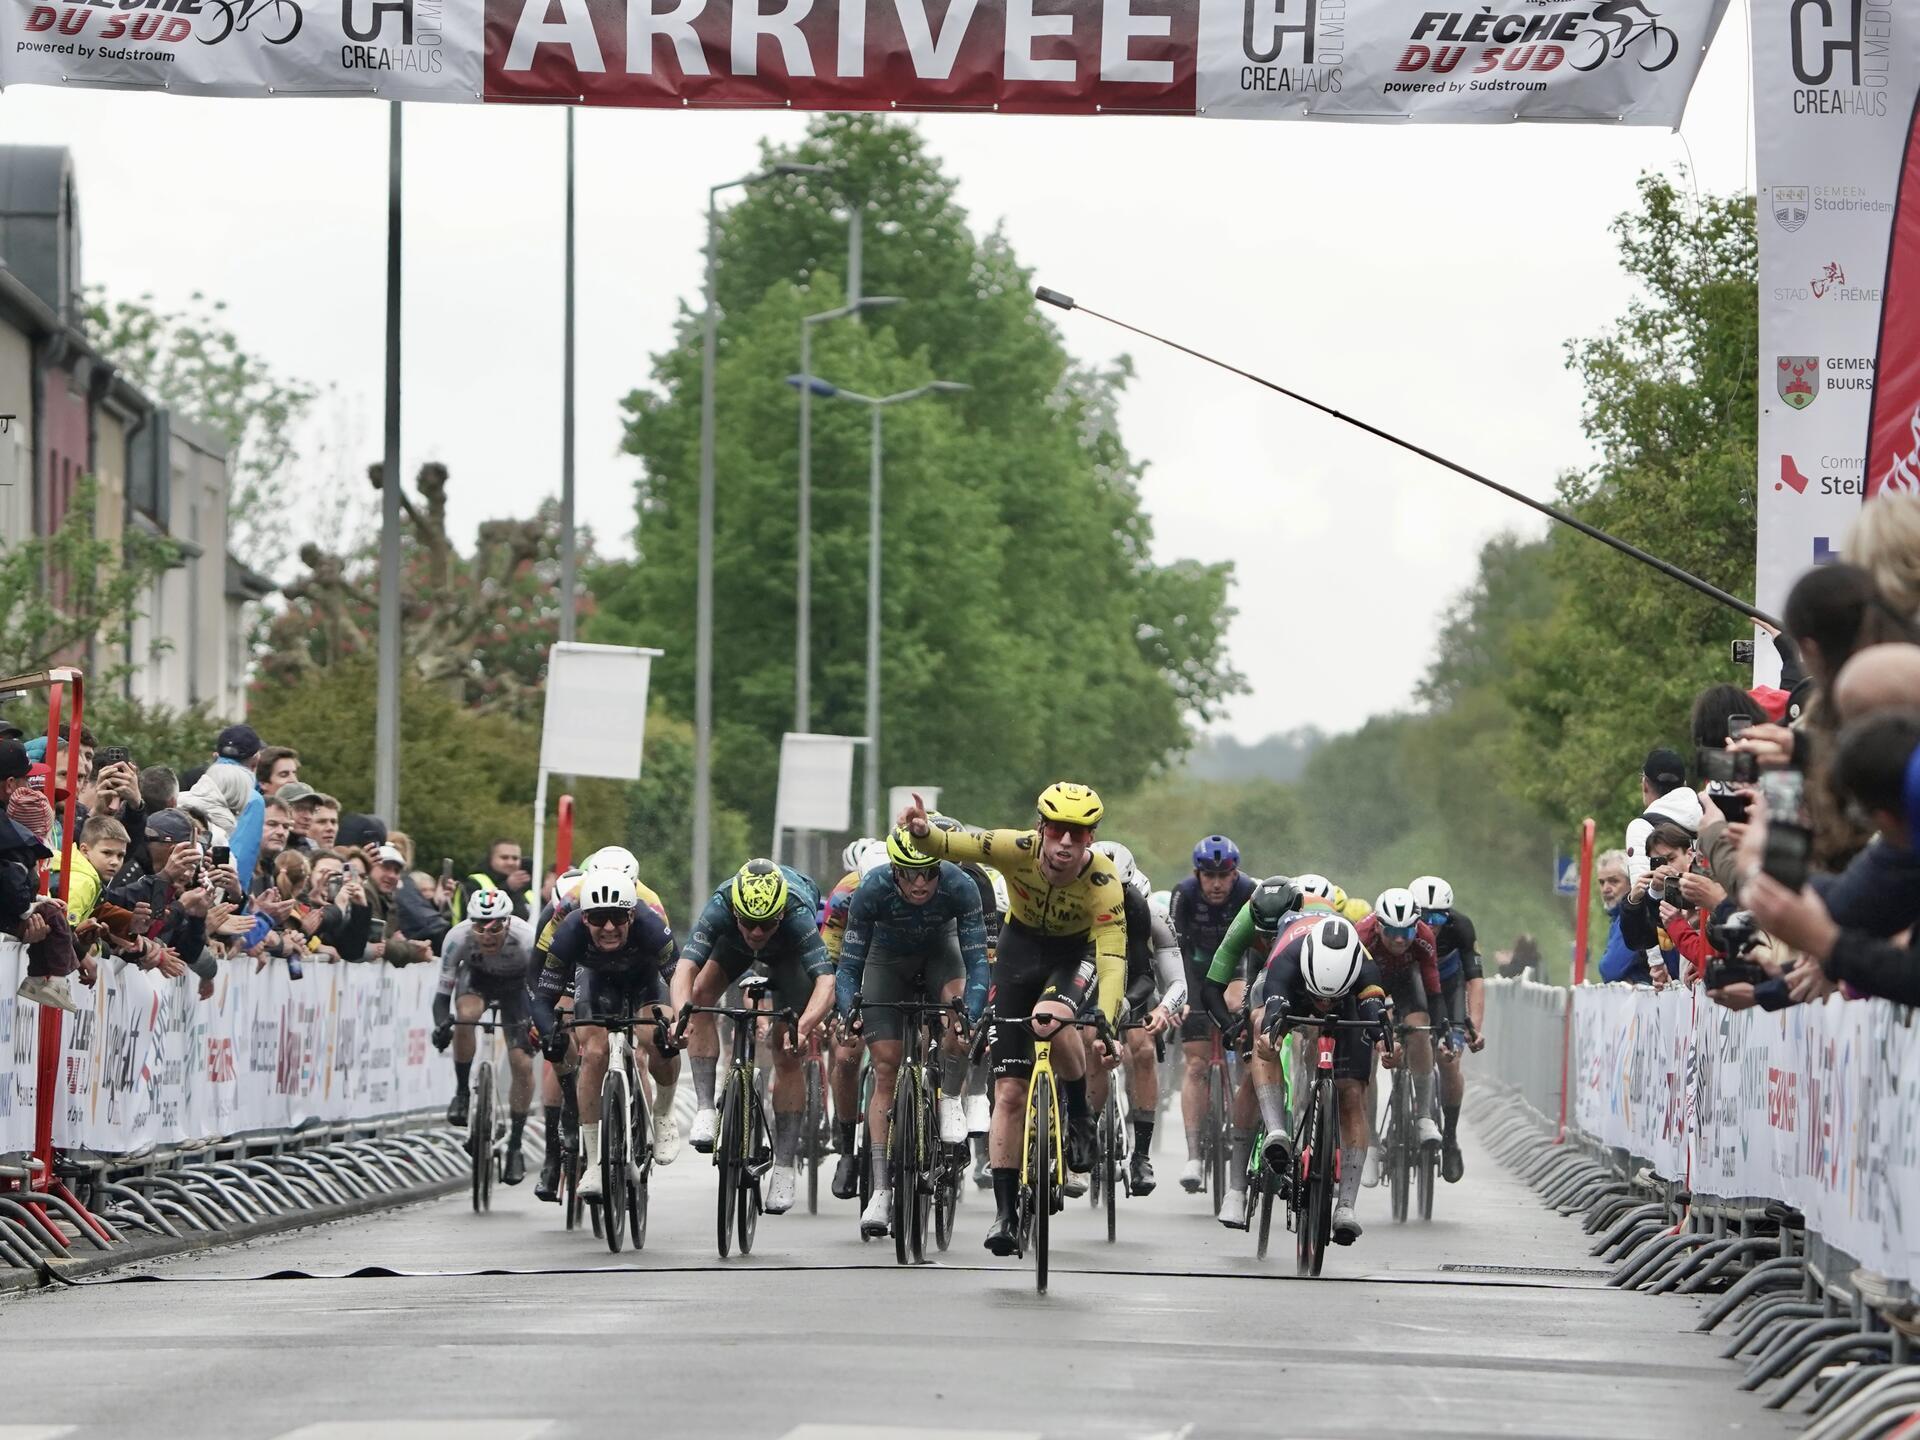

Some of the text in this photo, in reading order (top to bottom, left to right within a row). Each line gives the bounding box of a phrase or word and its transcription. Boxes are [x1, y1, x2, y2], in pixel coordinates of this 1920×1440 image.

[24, 6, 92, 35] DU
[98, 13, 192, 42] SUD
[1410, 6, 1590, 43] FLÈCHE
[17, 41, 175, 62] powered by Sudstroum
[341, 45, 442, 73] CREAHAUS
[1393, 45, 1565, 73] DU SUD
[1241, 66, 1343, 93] CREAHAUS
[1384, 79, 1547, 94] powered by Sudstroum
[1793, 89, 1888, 116] CREAHAUS
[1814, 186, 1866, 197] GEMEEN
[1774, 288, 1808, 301] STAD
